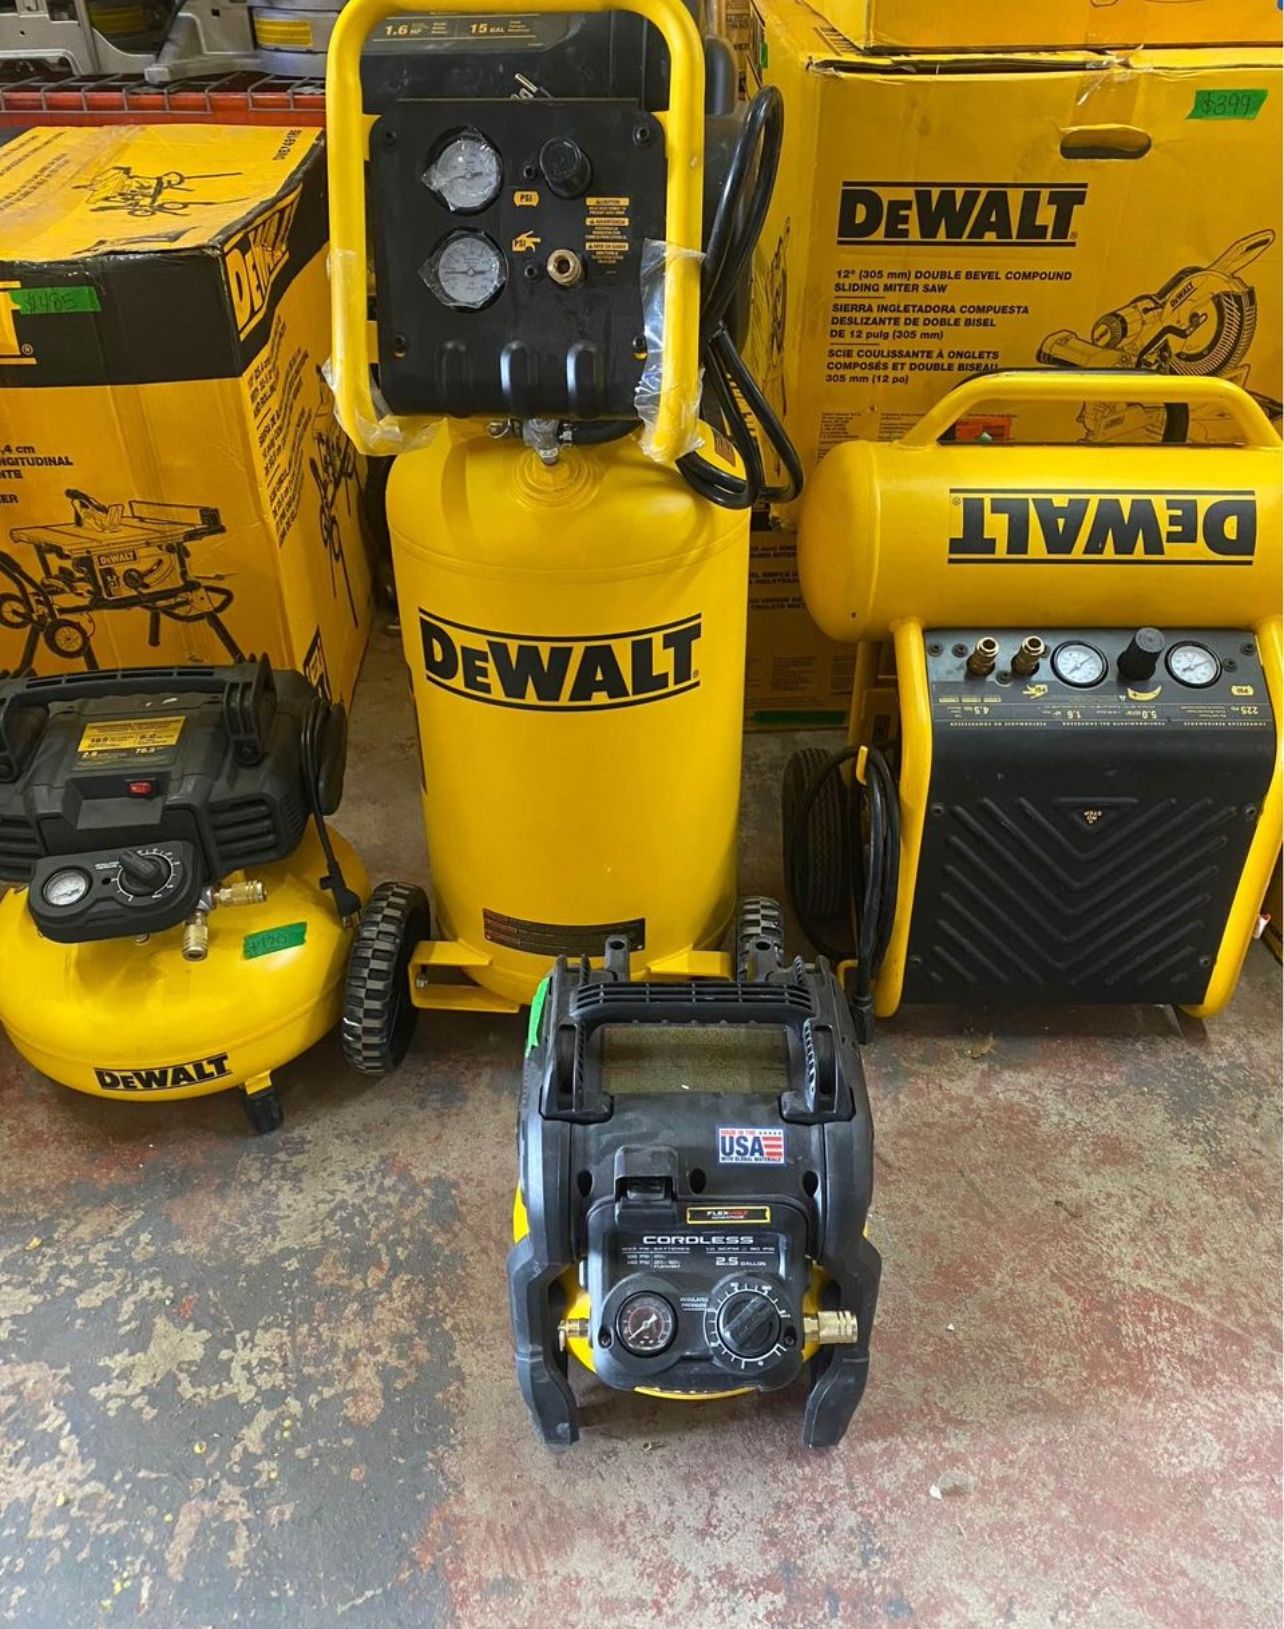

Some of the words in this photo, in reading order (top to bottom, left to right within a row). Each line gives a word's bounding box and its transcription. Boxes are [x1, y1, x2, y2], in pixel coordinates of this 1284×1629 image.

[385, 24, 408, 35] 1.6
[471, 24, 489, 34] 15
[1201, 92, 1252, 116] $399
[520, 194, 533, 202] PSI
[514, 240, 528, 248] PSI
[859, 270, 884, 280] (305
[887, 270, 911, 281] mm)
[915, 271, 961, 280] DOUBLE
[965, 271, 1001, 280] BEVEL
[1005, 271, 1072, 281] COMPOUND
[834, 283, 880, 292] SLIDING
[883, 283, 919, 293] MITER
[922, 284, 948, 293] SAW
[832, 304, 873, 313] SIERRA
[876, 304, 956, 314] INGLETADORA
[959, 305, 1029, 314] COMPUESTA
[831, 317, 901, 326] DESLIZANTE
[904, 317, 920, 326] DE
[923, 317, 961, 327] DOBLE
[964, 318, 996, 327] BISEL
[830, 329, 846, 338] DE
[849, 330, 863, 338] 12
[892, 330, 917, 341] (305
[920, 330, 944, 341] mm)
[827, 349, 853, 358] SCIE
[856, 349, 933, 359] COULISSANTE
[947, 350, 999, 360] ONGLETS
[827, 360, 888, 371] COMPOSÉS
[891, 362, 905, 371] ET
[908, 362, 954, 372] DOUBLE
[957, 363, 999, 372] BISEAU
[825, 374, 846, 383] 305
[849, 375, 868, 383] mm
[872, 374, 889, 384] (12
[892, 375, 909, 385] po)
[15, 446, 35, 454] cm
[1142, 709, 1157, 719] 5.0
[1240, 705, 1259, 714] 225
[721, 1136, 764, 1157] USA
[643, 1236, 754, 1245] CORDLESS
[716, 1256, 739, 1266] 2.5
